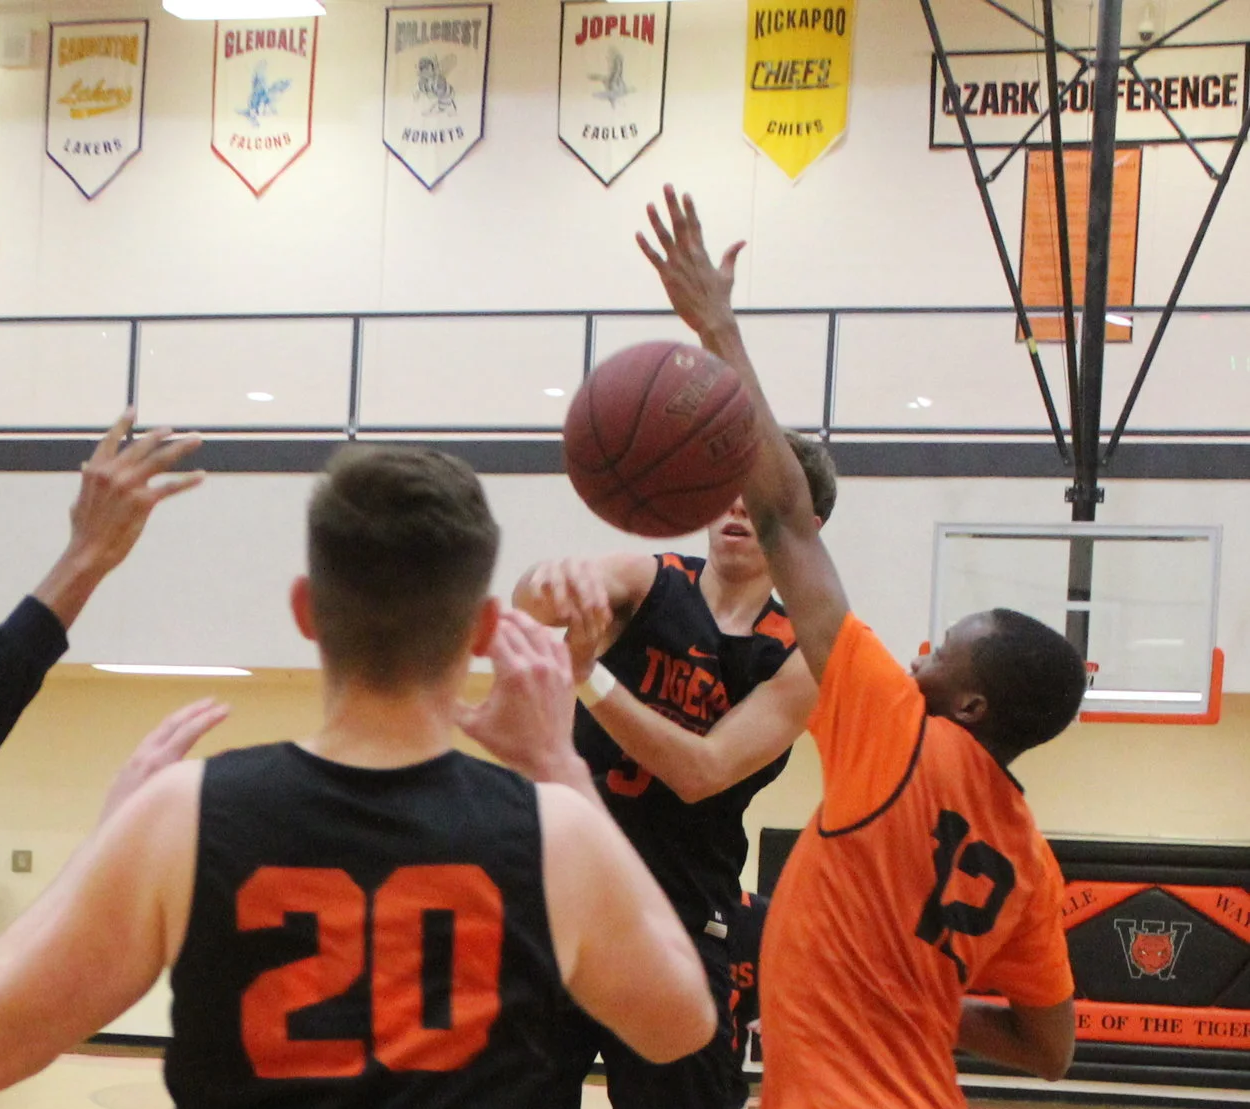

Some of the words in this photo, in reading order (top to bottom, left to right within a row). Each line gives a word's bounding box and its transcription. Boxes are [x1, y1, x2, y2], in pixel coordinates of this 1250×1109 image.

[575, 14, 655, 46] JOPLIN
[754, 7, 846, 40] KICKAPOO
[224, 26, 307, 59] GLENDALE
[942, 80, 1040, 116] OZARK
[402, 126, 464, 144] HORNETS
[582, 122, 639, 140] EAGLES
[767, 119, 823, 136] CHIEFS
[63, 138, 123, 155] LAKERS
[230, 131, 292, 150] FALCONS
[235, 864, 504, 1078] 20
[1101, 1015, 1129, 1031] OF
[1140, 1016, 1183, 1033] THE
